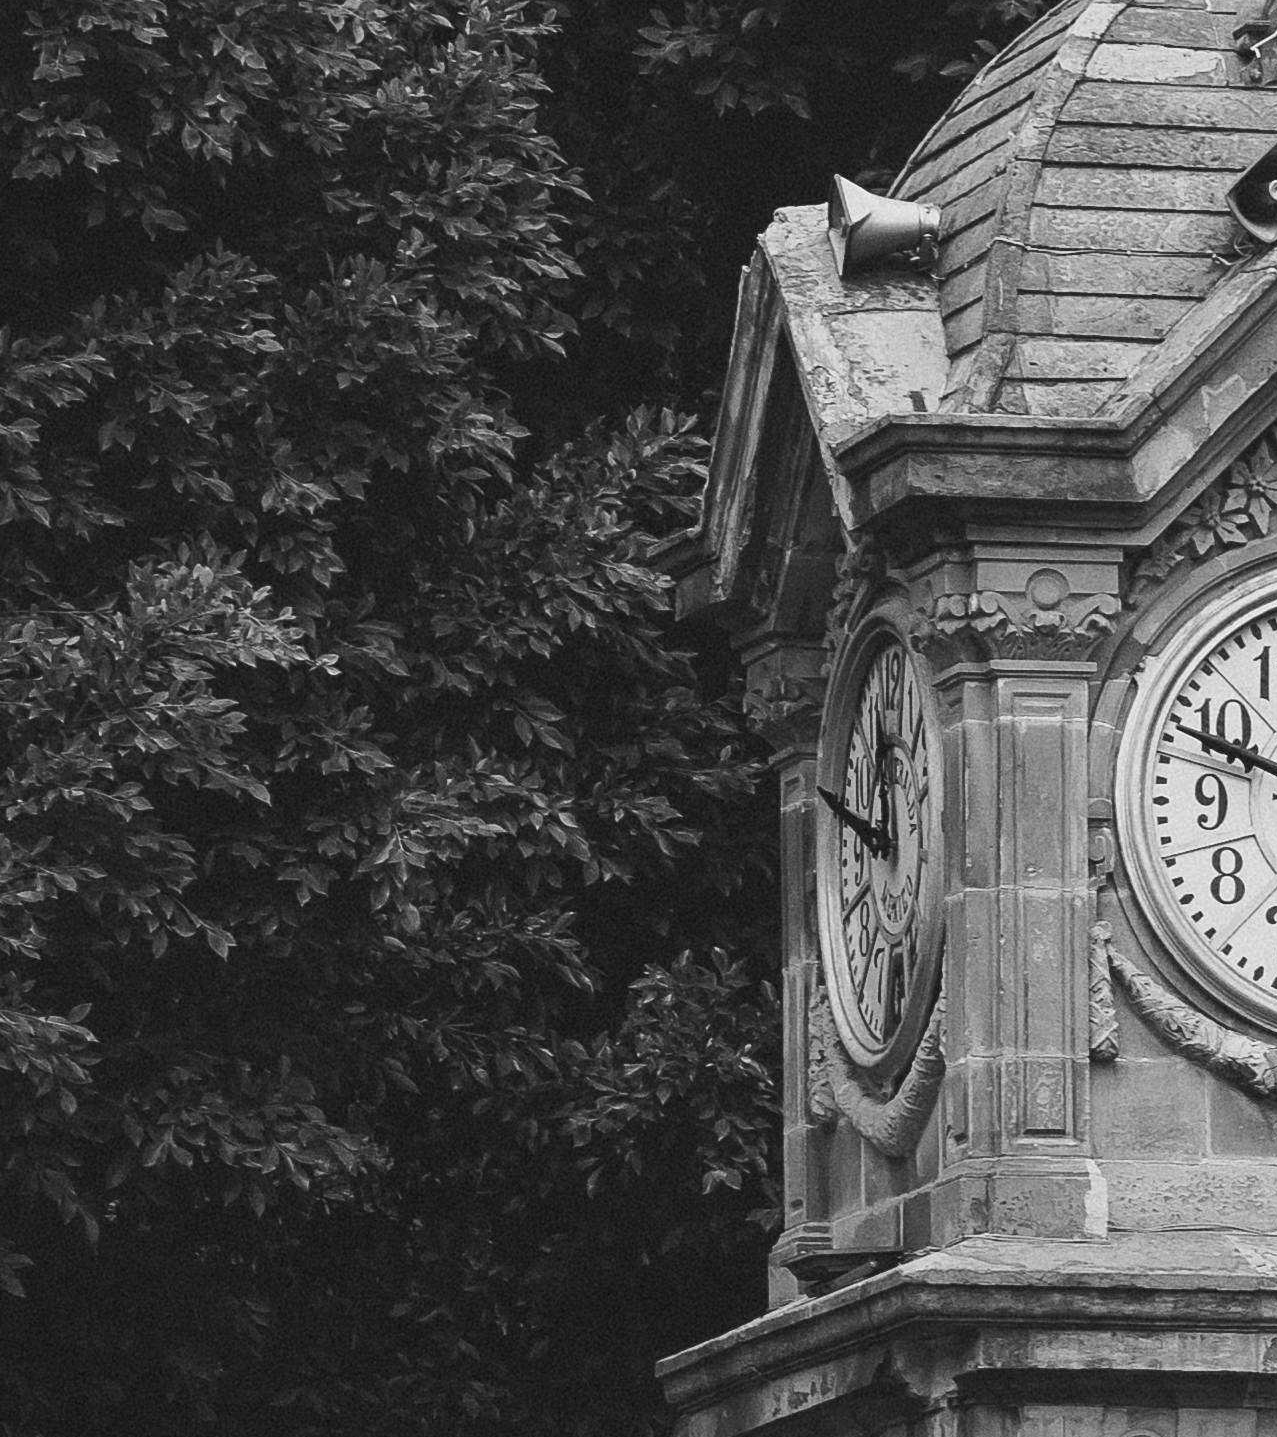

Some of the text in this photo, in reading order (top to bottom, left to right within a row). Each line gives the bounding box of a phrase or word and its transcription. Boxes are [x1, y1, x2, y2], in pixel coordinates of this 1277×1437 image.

[1194, 697, 1252, 756] 10
[1195, 773, 1228, 830] 9
[1209, 847, 1245, 904] 8
